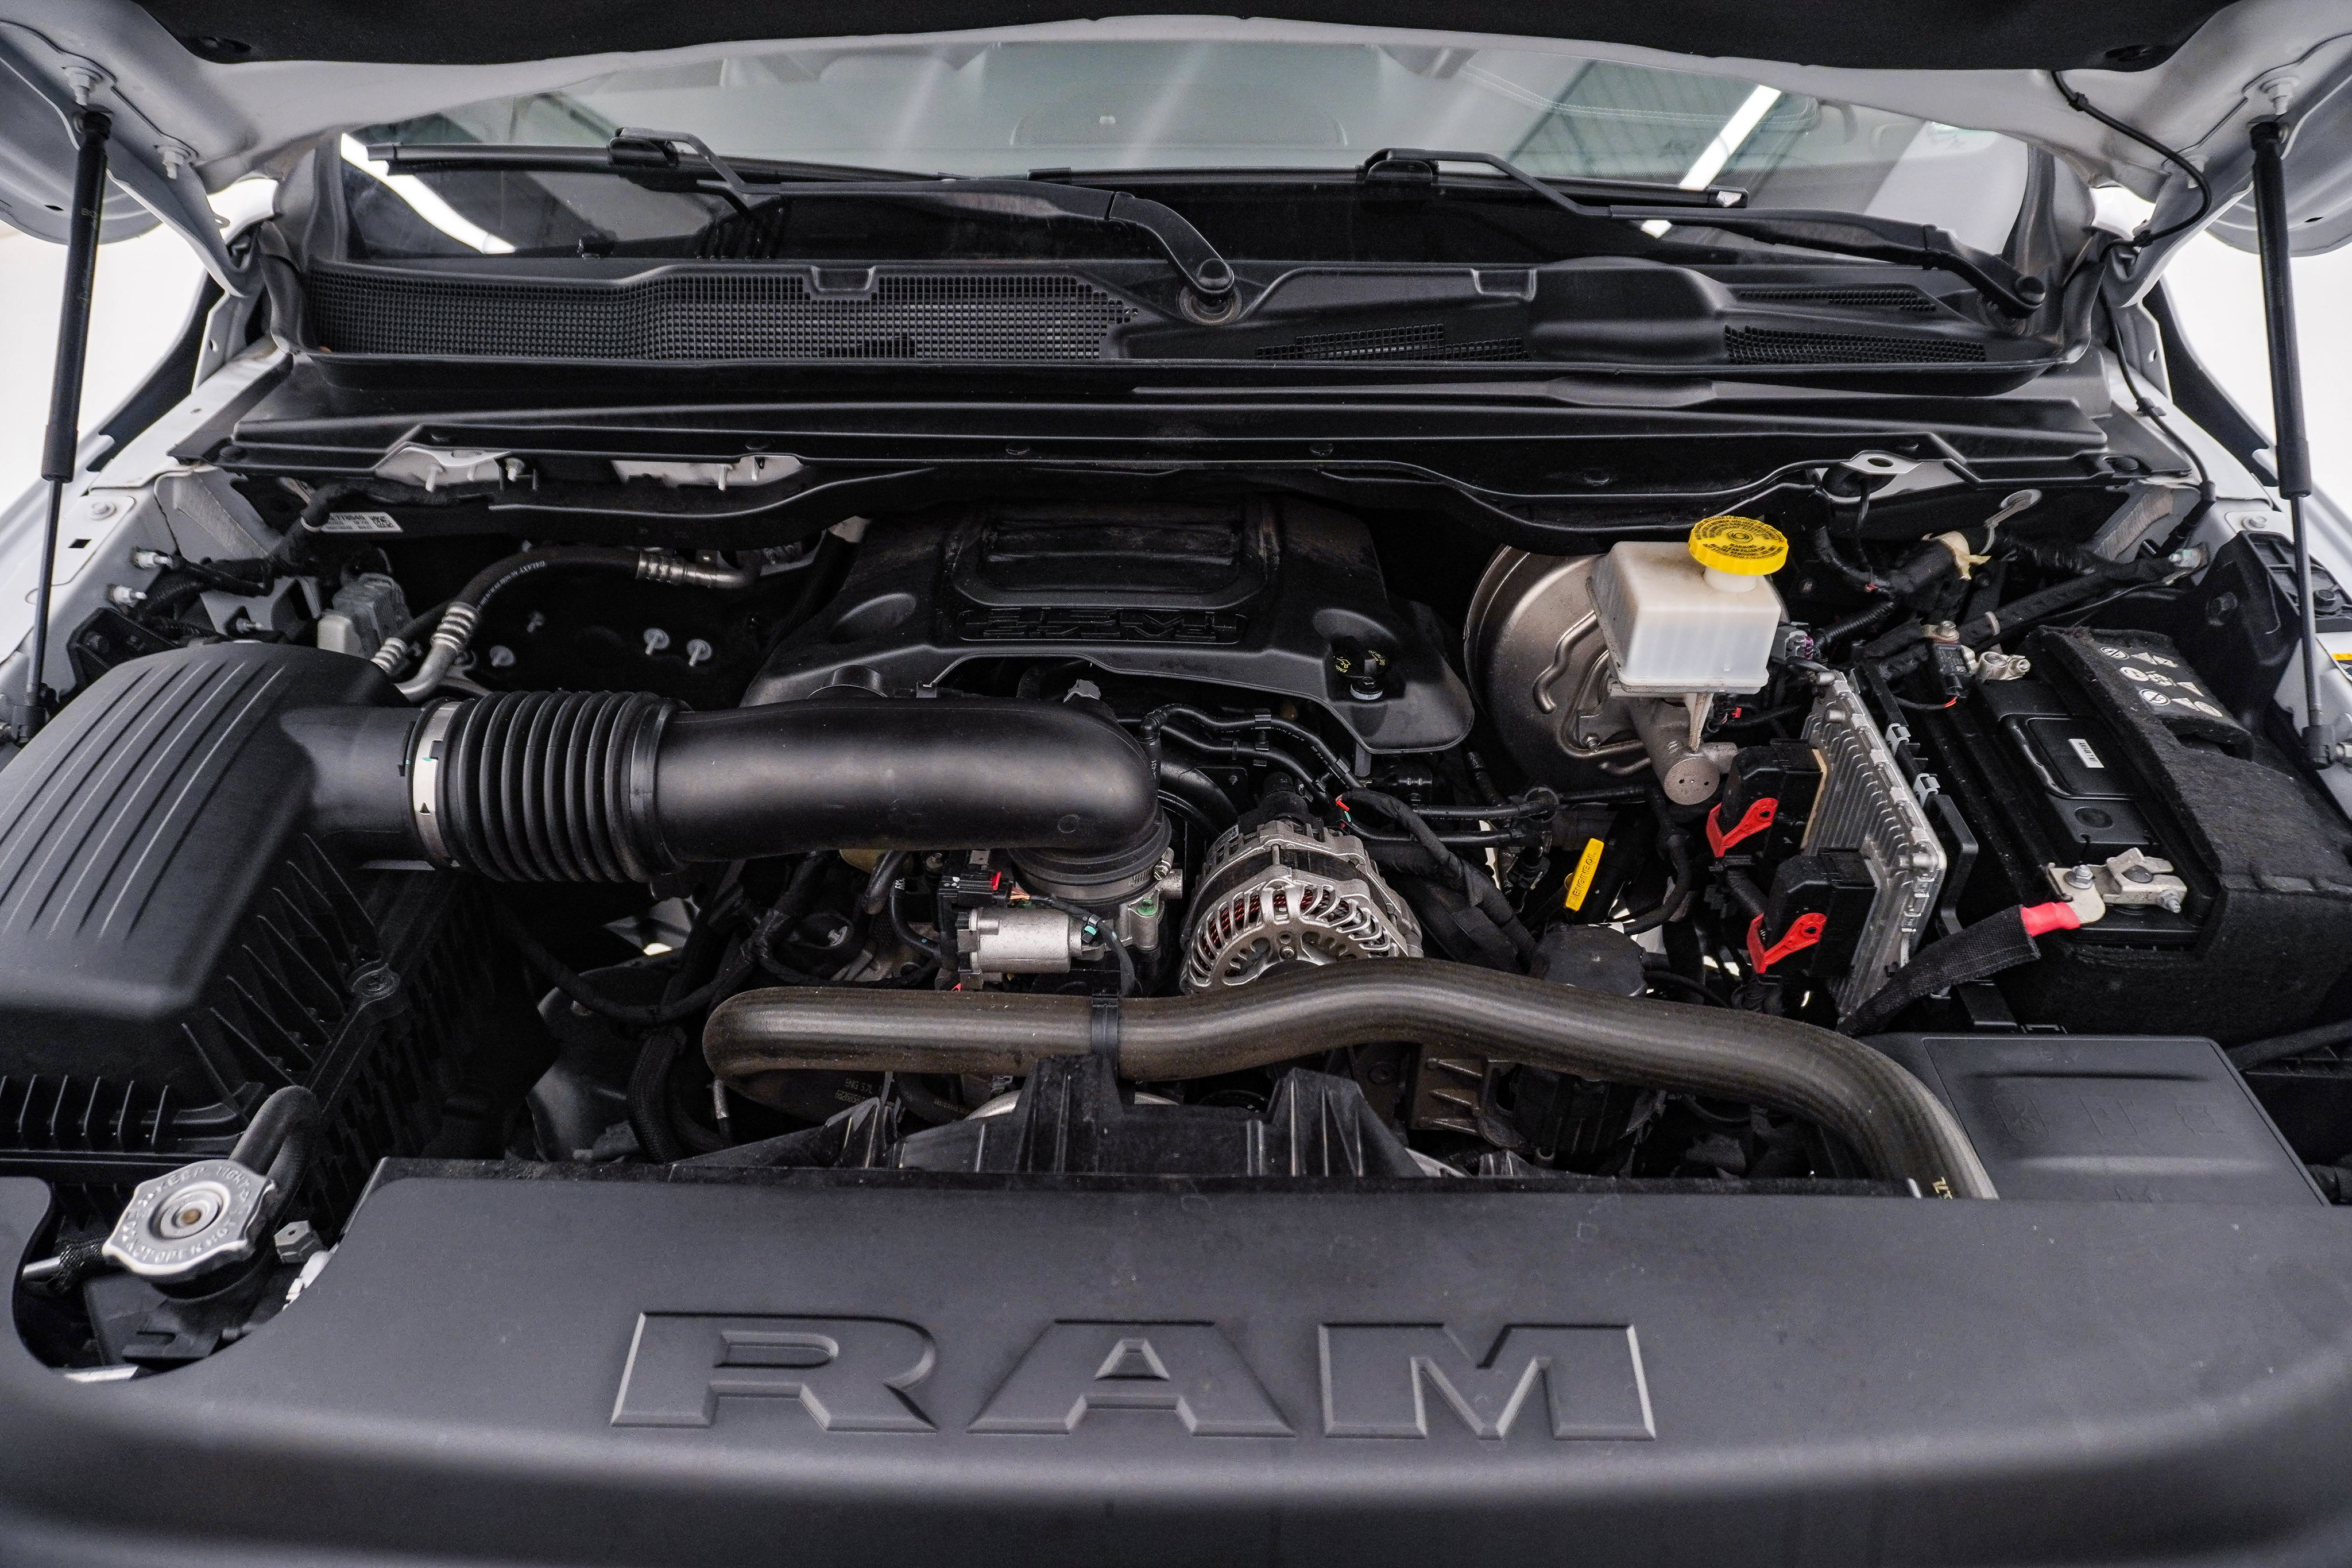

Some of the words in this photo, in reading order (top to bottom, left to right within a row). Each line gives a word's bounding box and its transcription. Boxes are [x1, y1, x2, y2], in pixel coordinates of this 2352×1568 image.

[1710, 543, 1729, 552] BEFORE
[1573, 865, 1590, 897] ENGINE
[1585, 853, 1596, 865] OIL
[609, 1311, 1658, 1441] RAM
